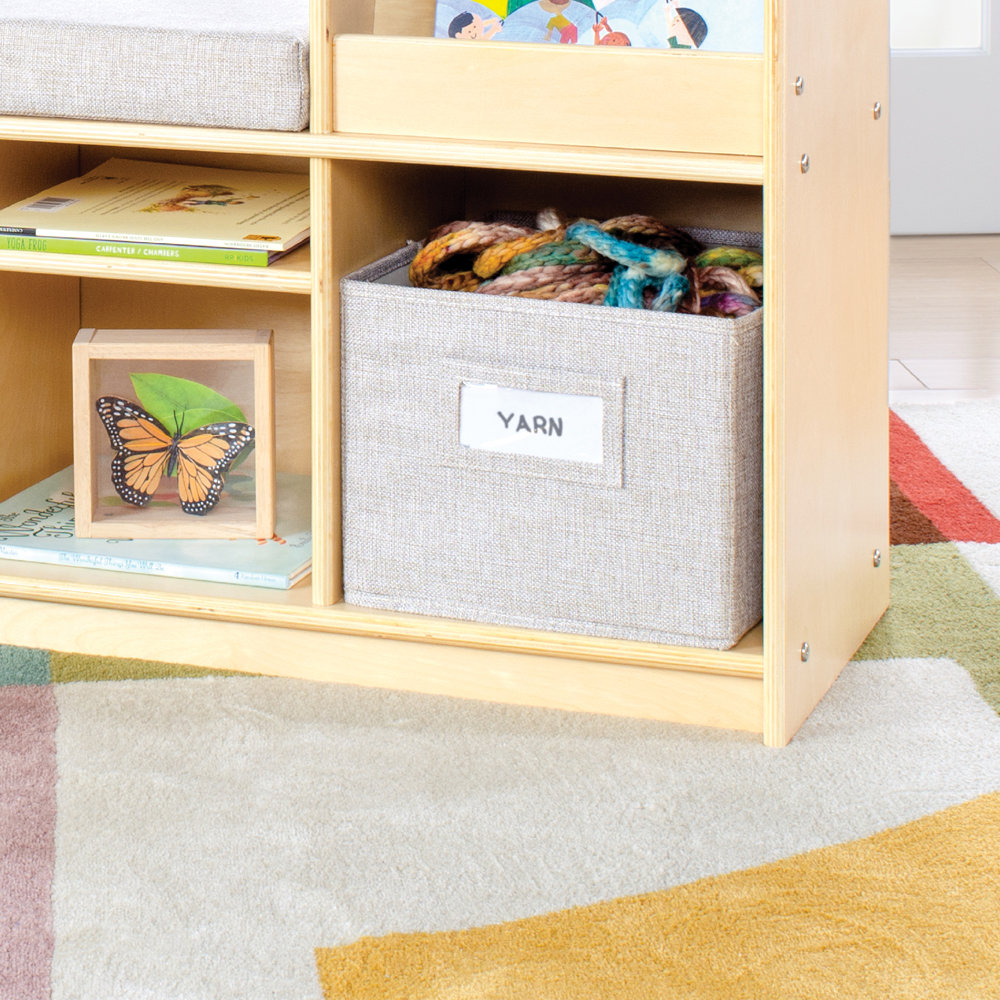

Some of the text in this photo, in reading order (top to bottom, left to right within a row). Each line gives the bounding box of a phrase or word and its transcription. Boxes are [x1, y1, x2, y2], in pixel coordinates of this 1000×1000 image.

[6, 237, 47, 251] YOGA FROG
[95, 246, 135, 255] CARPENTER
[143, 249, 180, 258] CHAMBERS
[497, 411, 563, 437] YARN
